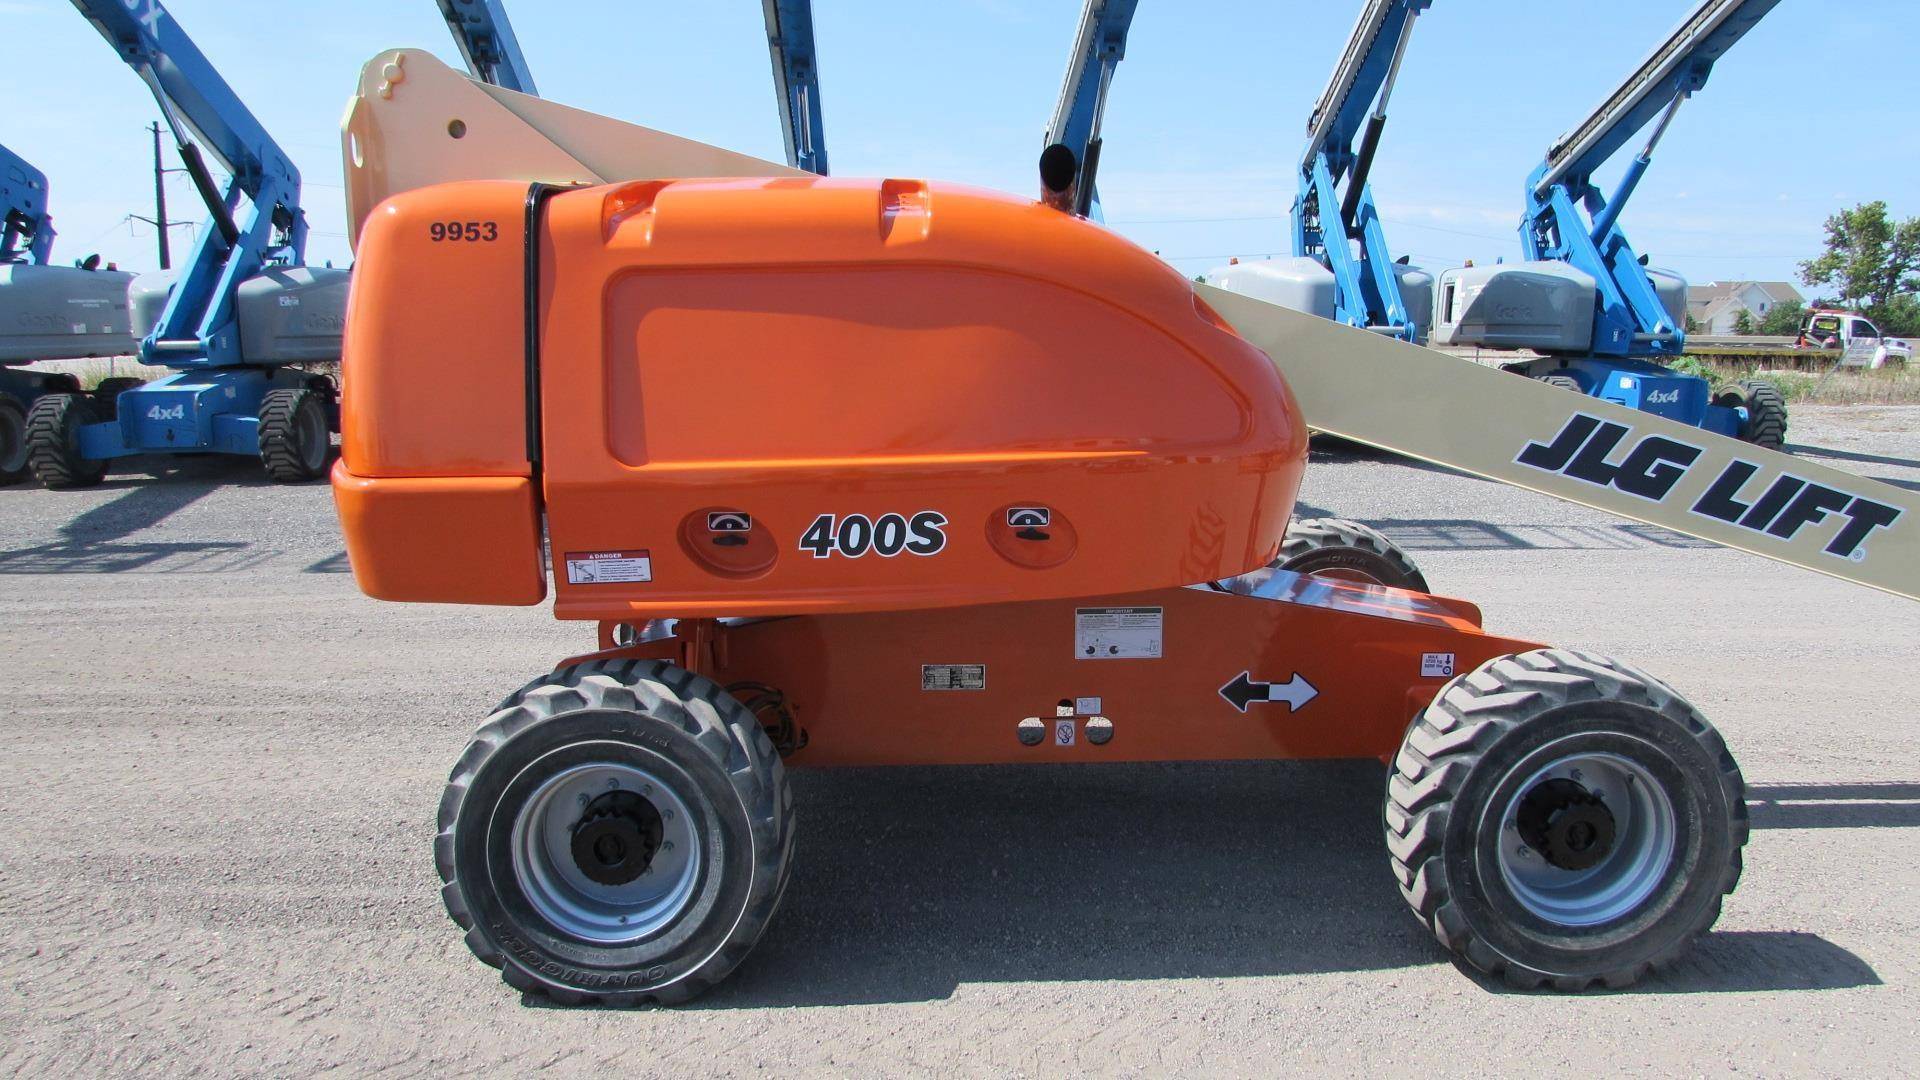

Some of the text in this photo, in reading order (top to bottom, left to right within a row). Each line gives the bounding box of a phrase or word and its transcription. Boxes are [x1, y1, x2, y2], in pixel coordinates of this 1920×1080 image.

[430, 221, 498, 242] 9953
[1646, 389, 1679, 404] 4x4
[147, 404, 185, 420] 4x4
[1512, 410, 1906, 559] JLG LIFT
[798, 510, 949, 559] 400S
